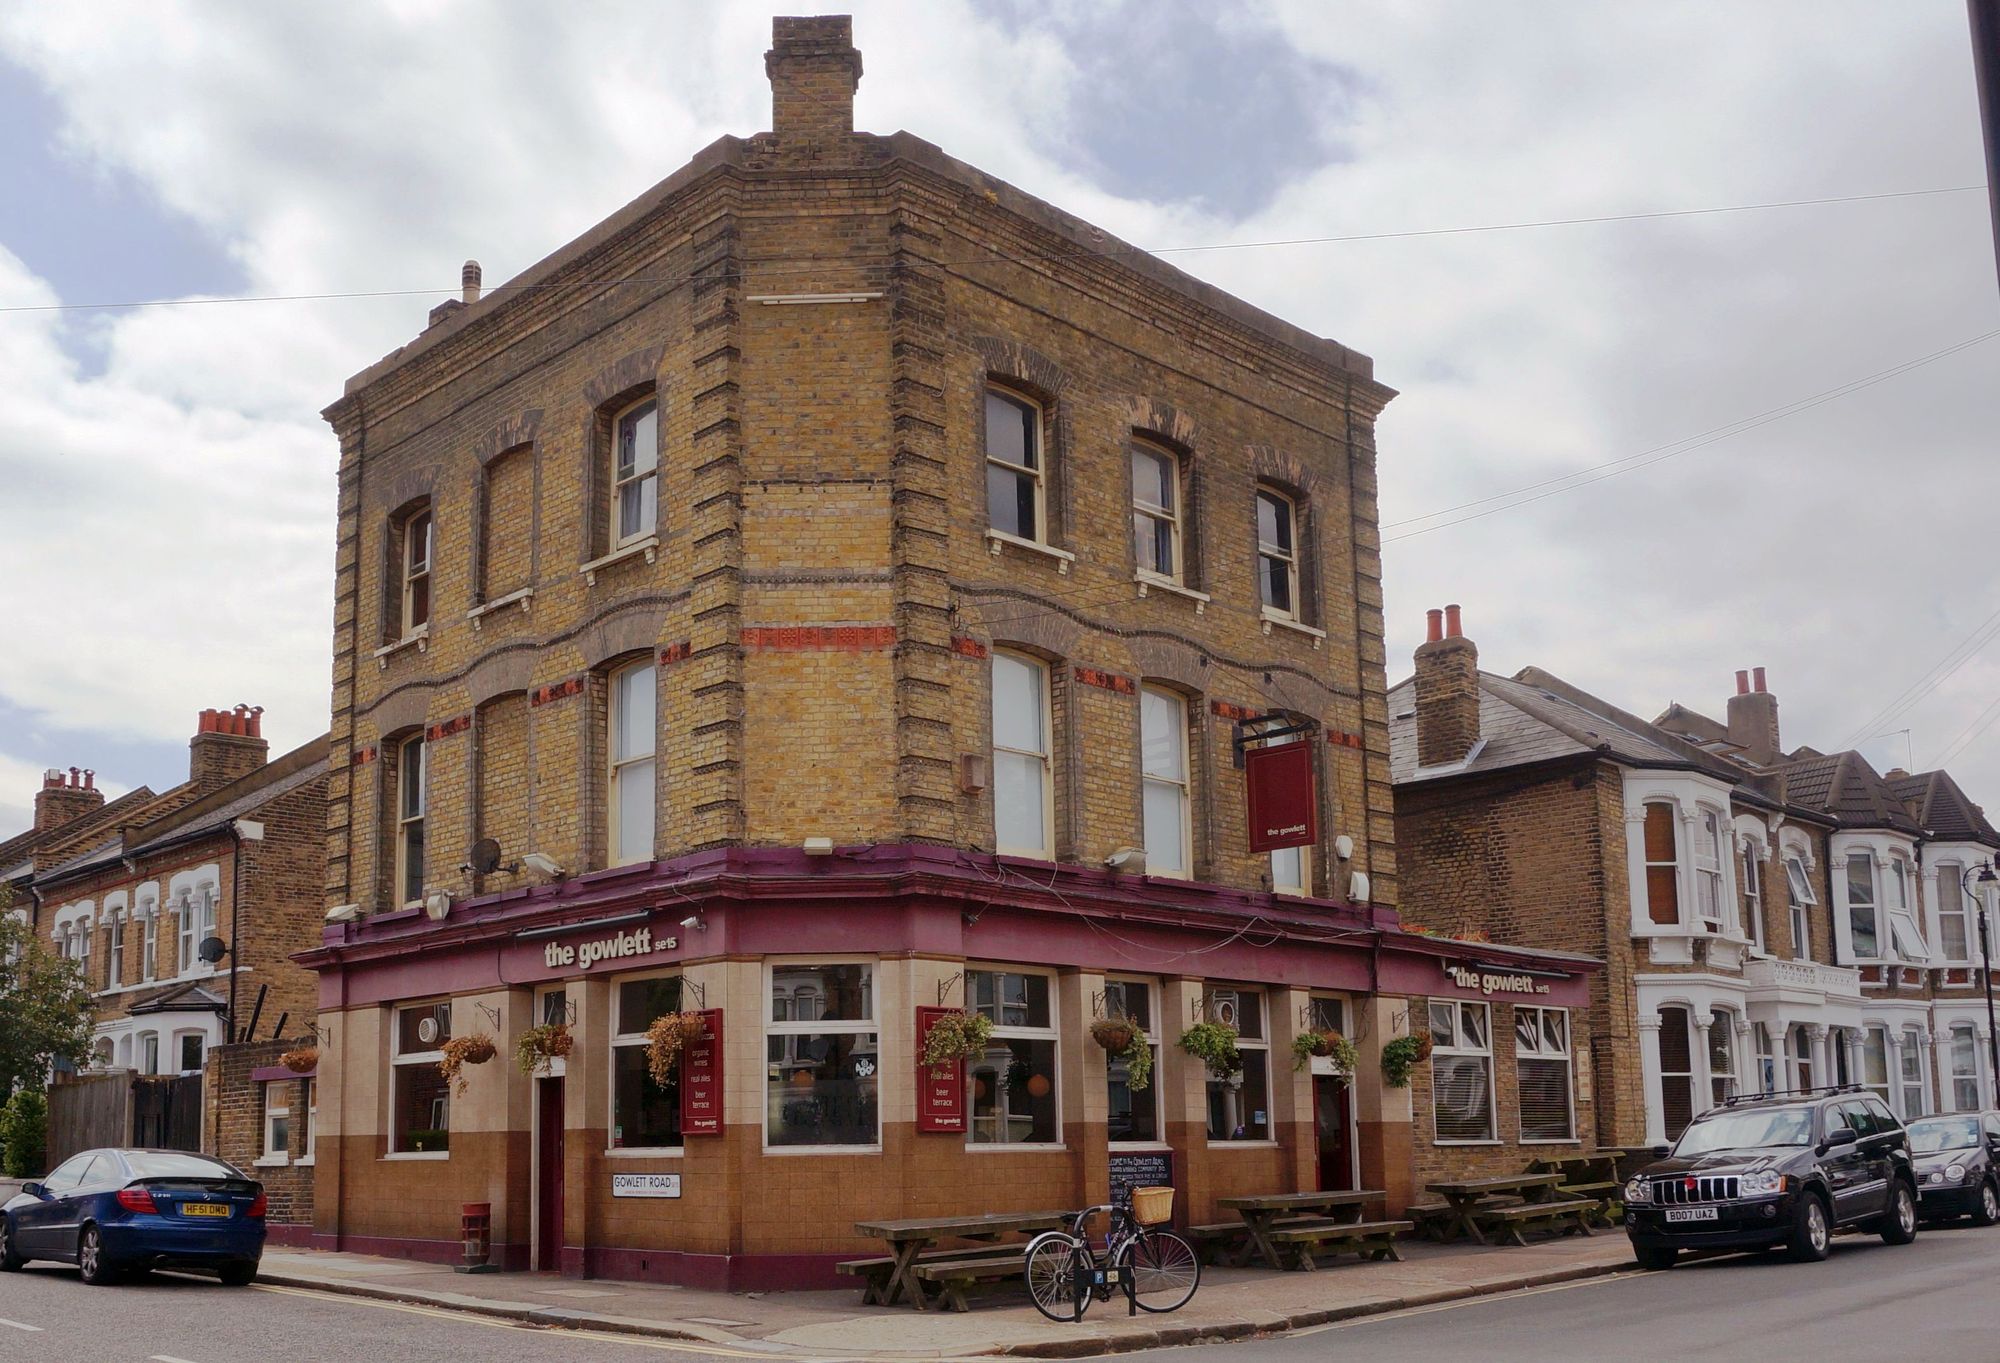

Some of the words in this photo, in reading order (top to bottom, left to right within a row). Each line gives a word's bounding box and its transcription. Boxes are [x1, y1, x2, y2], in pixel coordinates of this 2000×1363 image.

[1267, 828, 1278, 836] the
[1280, 824, 1306, 836] gowlett
[544, 941, 575, 967] the
[578, 927, 652, 969] gowlett
[655, 937, 677, 950] se15
[1455, 967, 1480, 988] the
[1482, 974, 1534, 995] gowlett
[1535, 985, 1550, 993] se15
[943, 1072, 954, 1080] ales
[695, 1091, 706, 1099] beer
[936, 1088, 949, 1096] beer
[692, 1101, 709, 1109] terrace
[933, 1098, 953, 1107] terrace
[614, 1176, 646, 1187] GOWLETT
[649, 1177, 671, 1188] ROAD
[186, 1204, 207, 1214] HF51
[1669, 1211, 1693, 1220] BD07
[1695, 1209, 1714, 1219] UAZ
